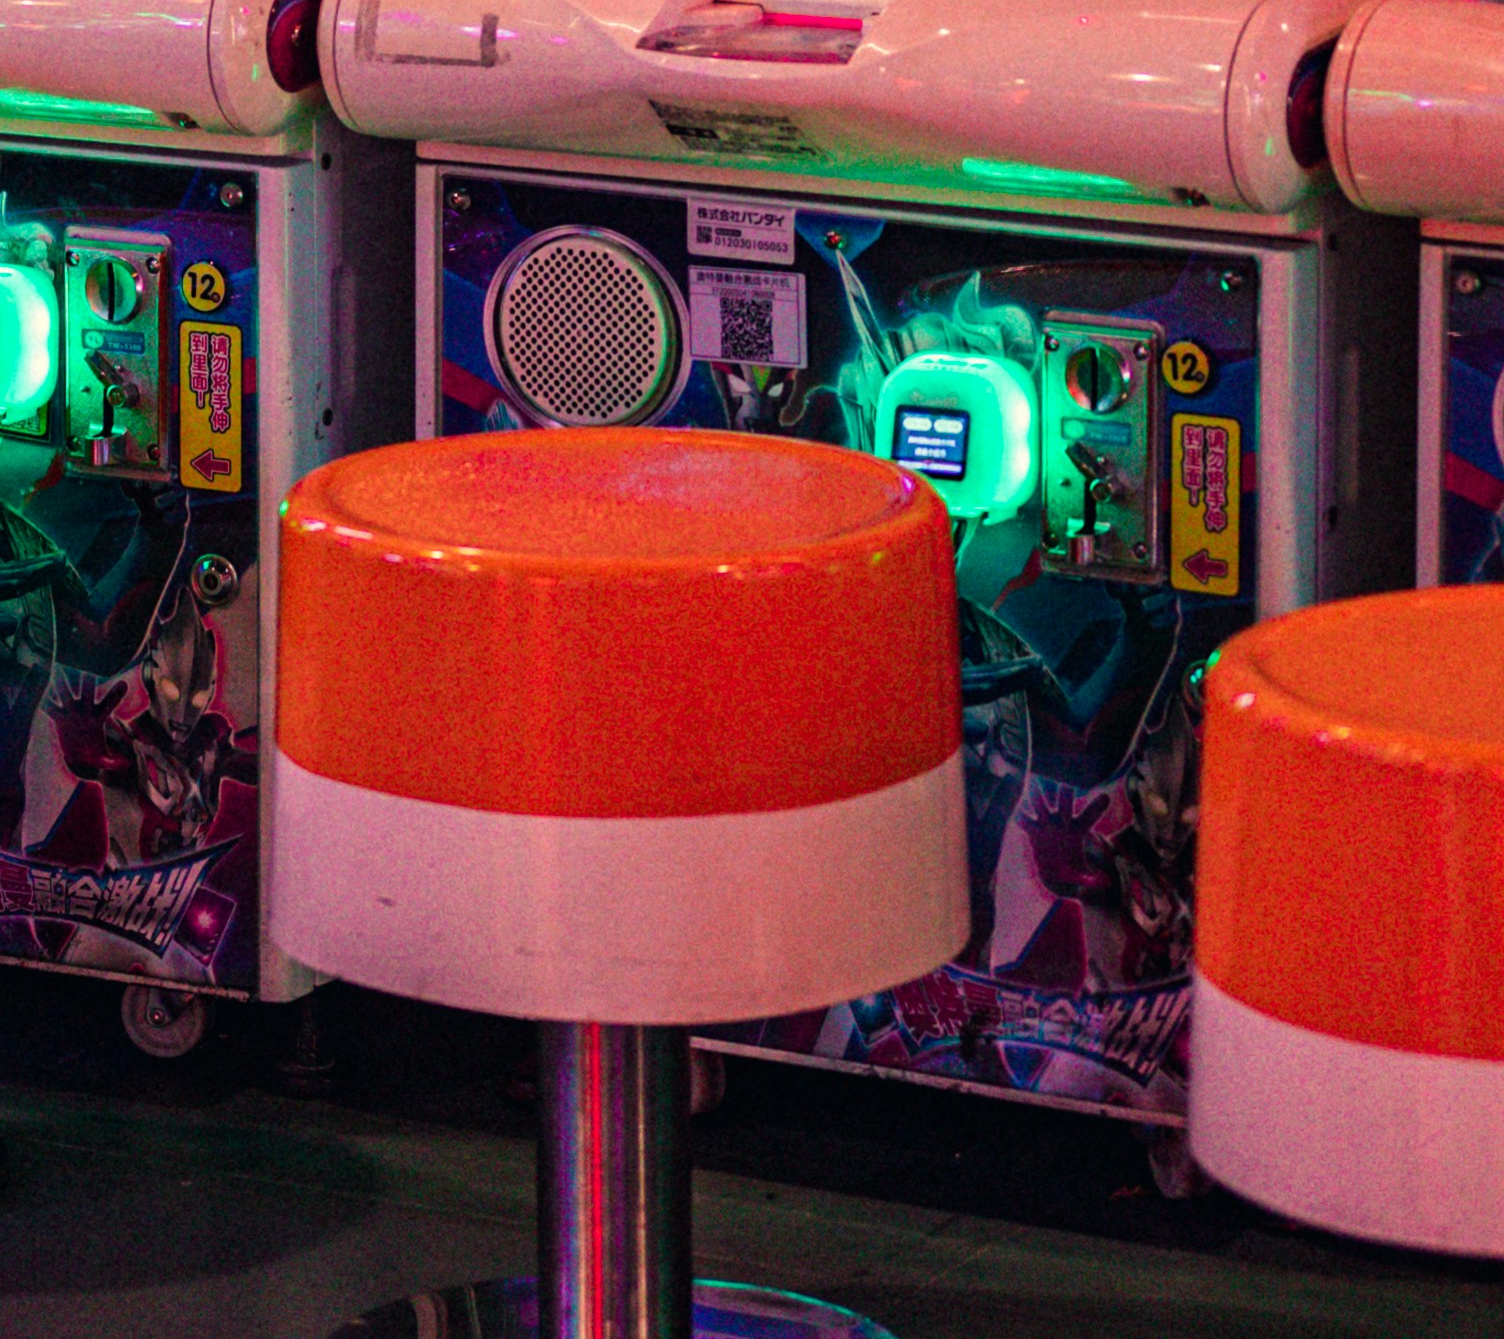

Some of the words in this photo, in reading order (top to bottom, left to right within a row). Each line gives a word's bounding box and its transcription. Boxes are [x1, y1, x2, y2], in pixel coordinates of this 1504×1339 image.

[696, 206, 786, 228] 株式会社バンダイ
[714, 236, 789, 253] 012030105053
[187, 271, 216, 303] 12
[210, 333, 233, 432] 请勿将手伸
[1166, 351, 1199, 383] 12
[1204, 425, 1230, 534] 请勿将手伸
